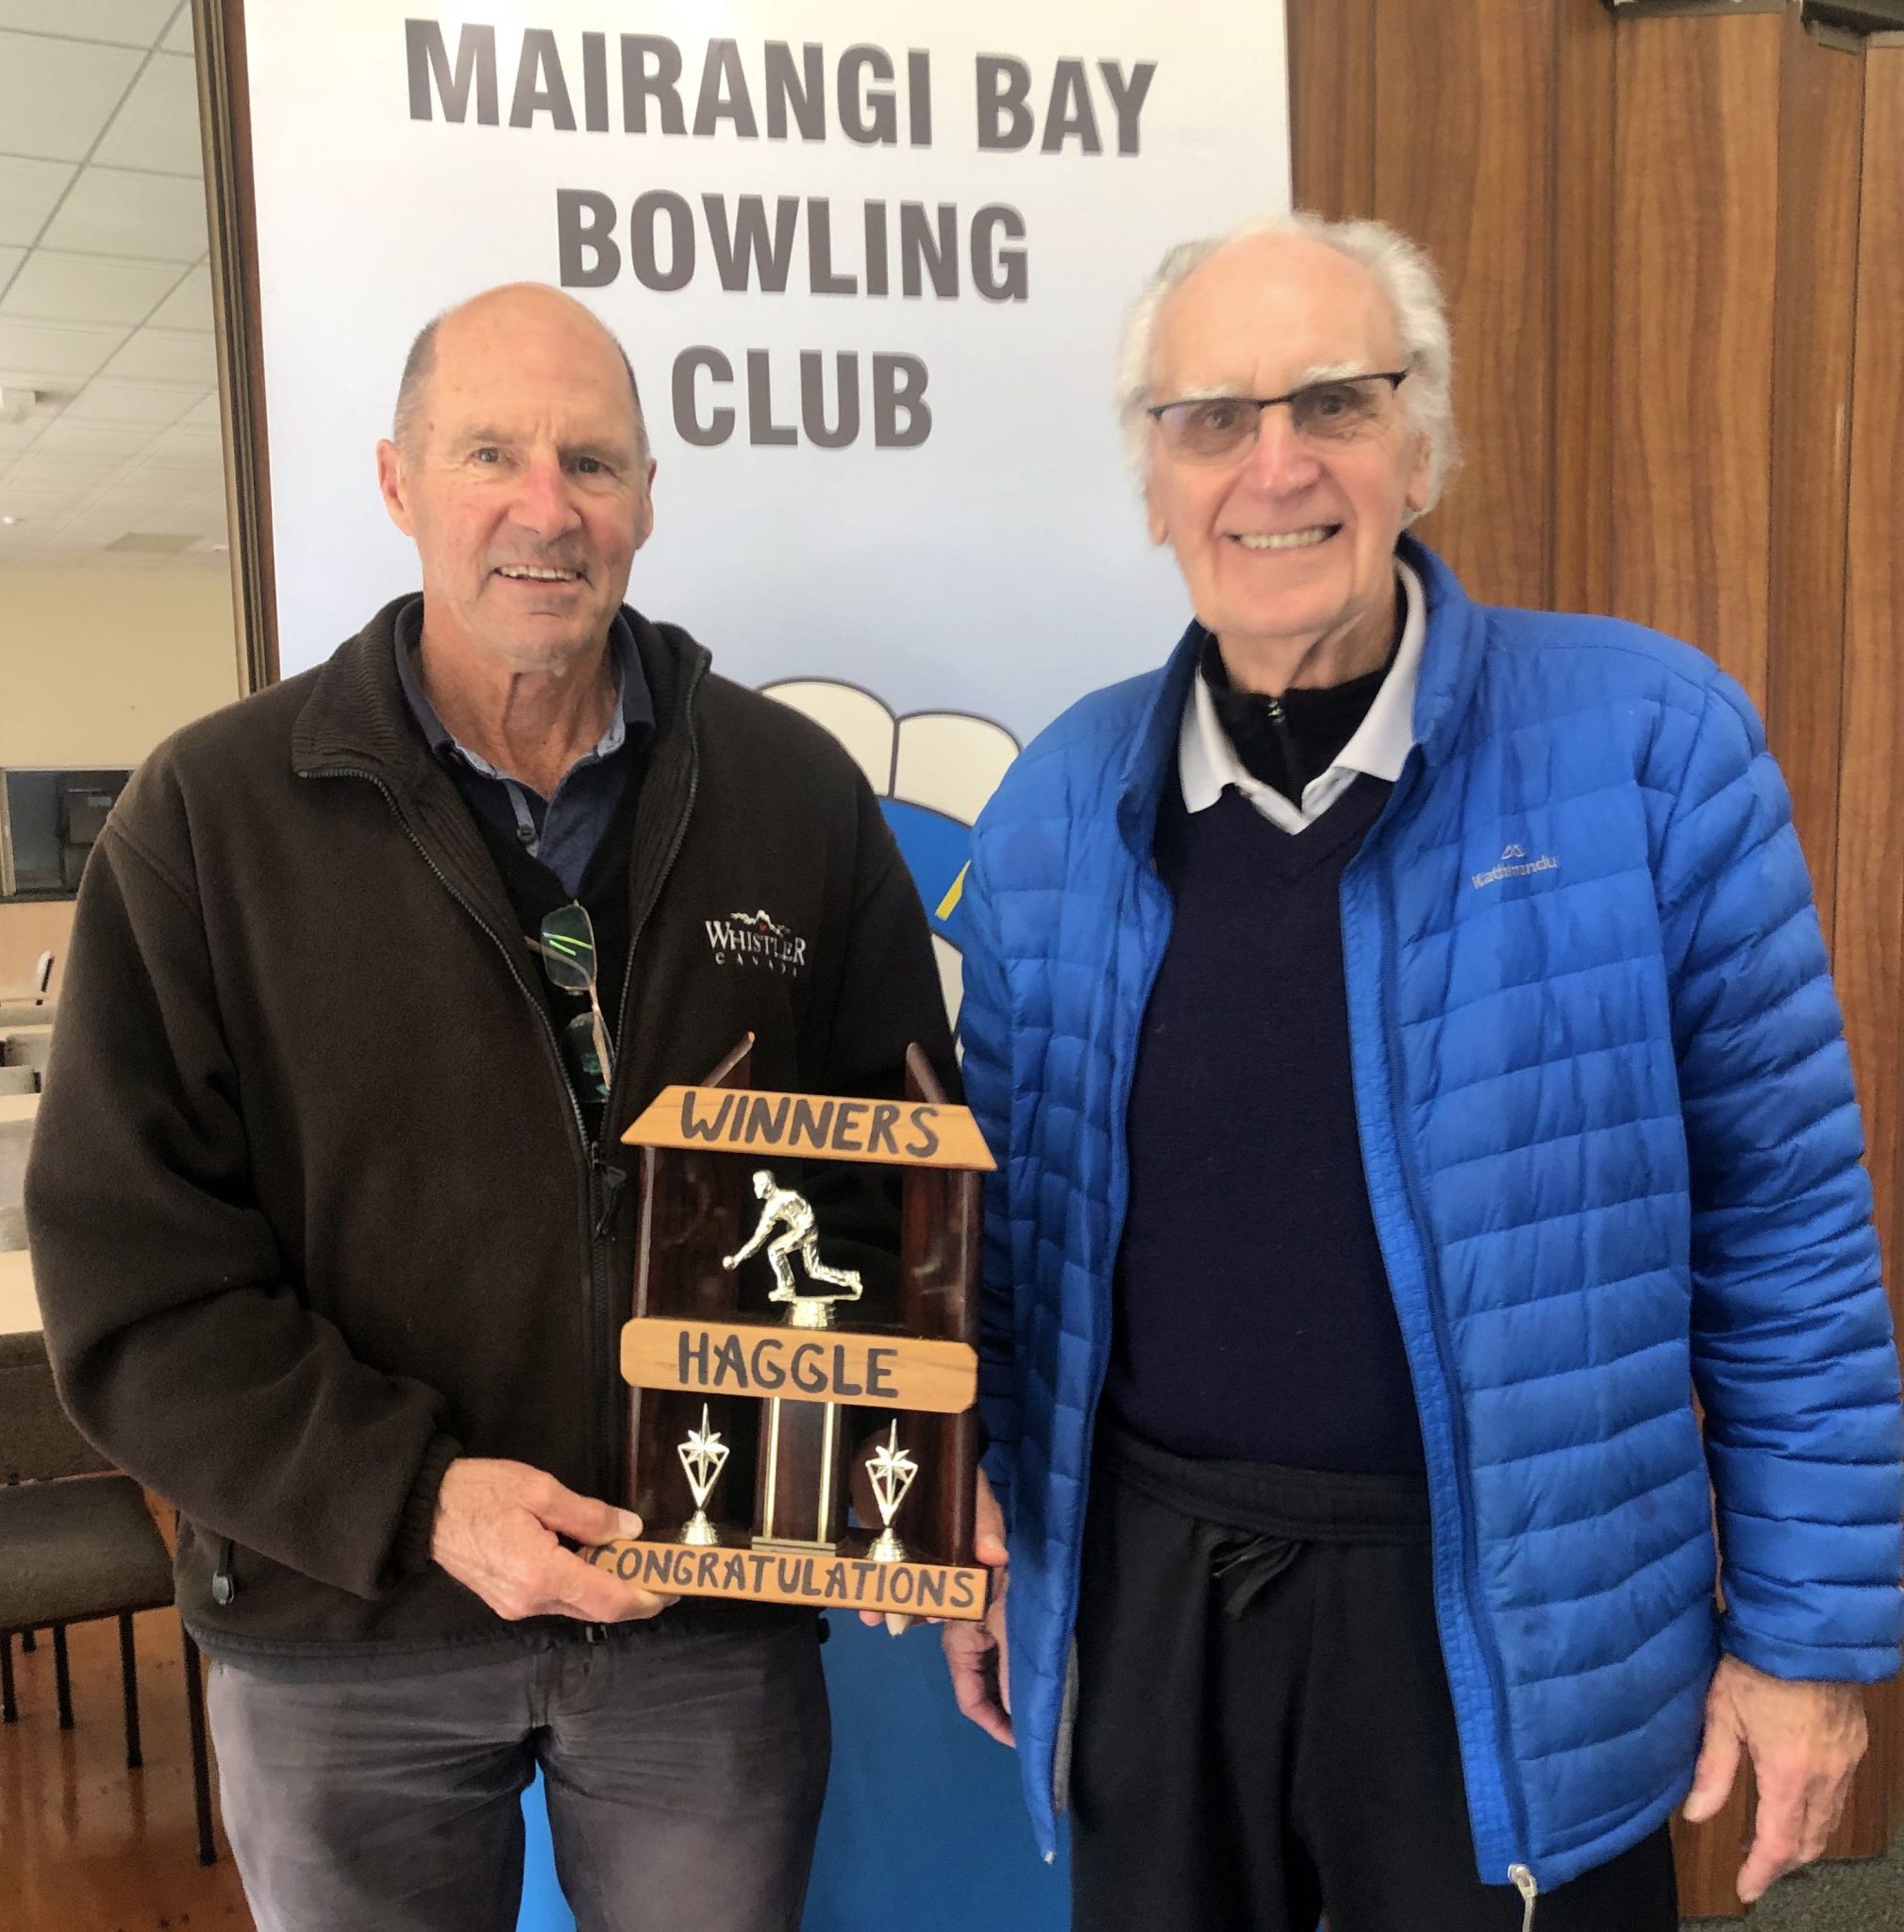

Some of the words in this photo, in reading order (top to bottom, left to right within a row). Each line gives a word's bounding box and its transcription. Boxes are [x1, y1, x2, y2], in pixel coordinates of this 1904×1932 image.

[404, 17, 933, 149] MAIRANGI
[975, 52, 1158, 158] BAY
[556, 188, 1030, 305] BOWLING
[670, 344, 932, 449] CLUB
[705, 920, 807, 965] WHISTLER
[679, 1090, 942, 1158] WINNERS
[677, 1330, 899, 1399] HAGGLE
[589, 1545, 977, 1609] CONGRATULATIONS
